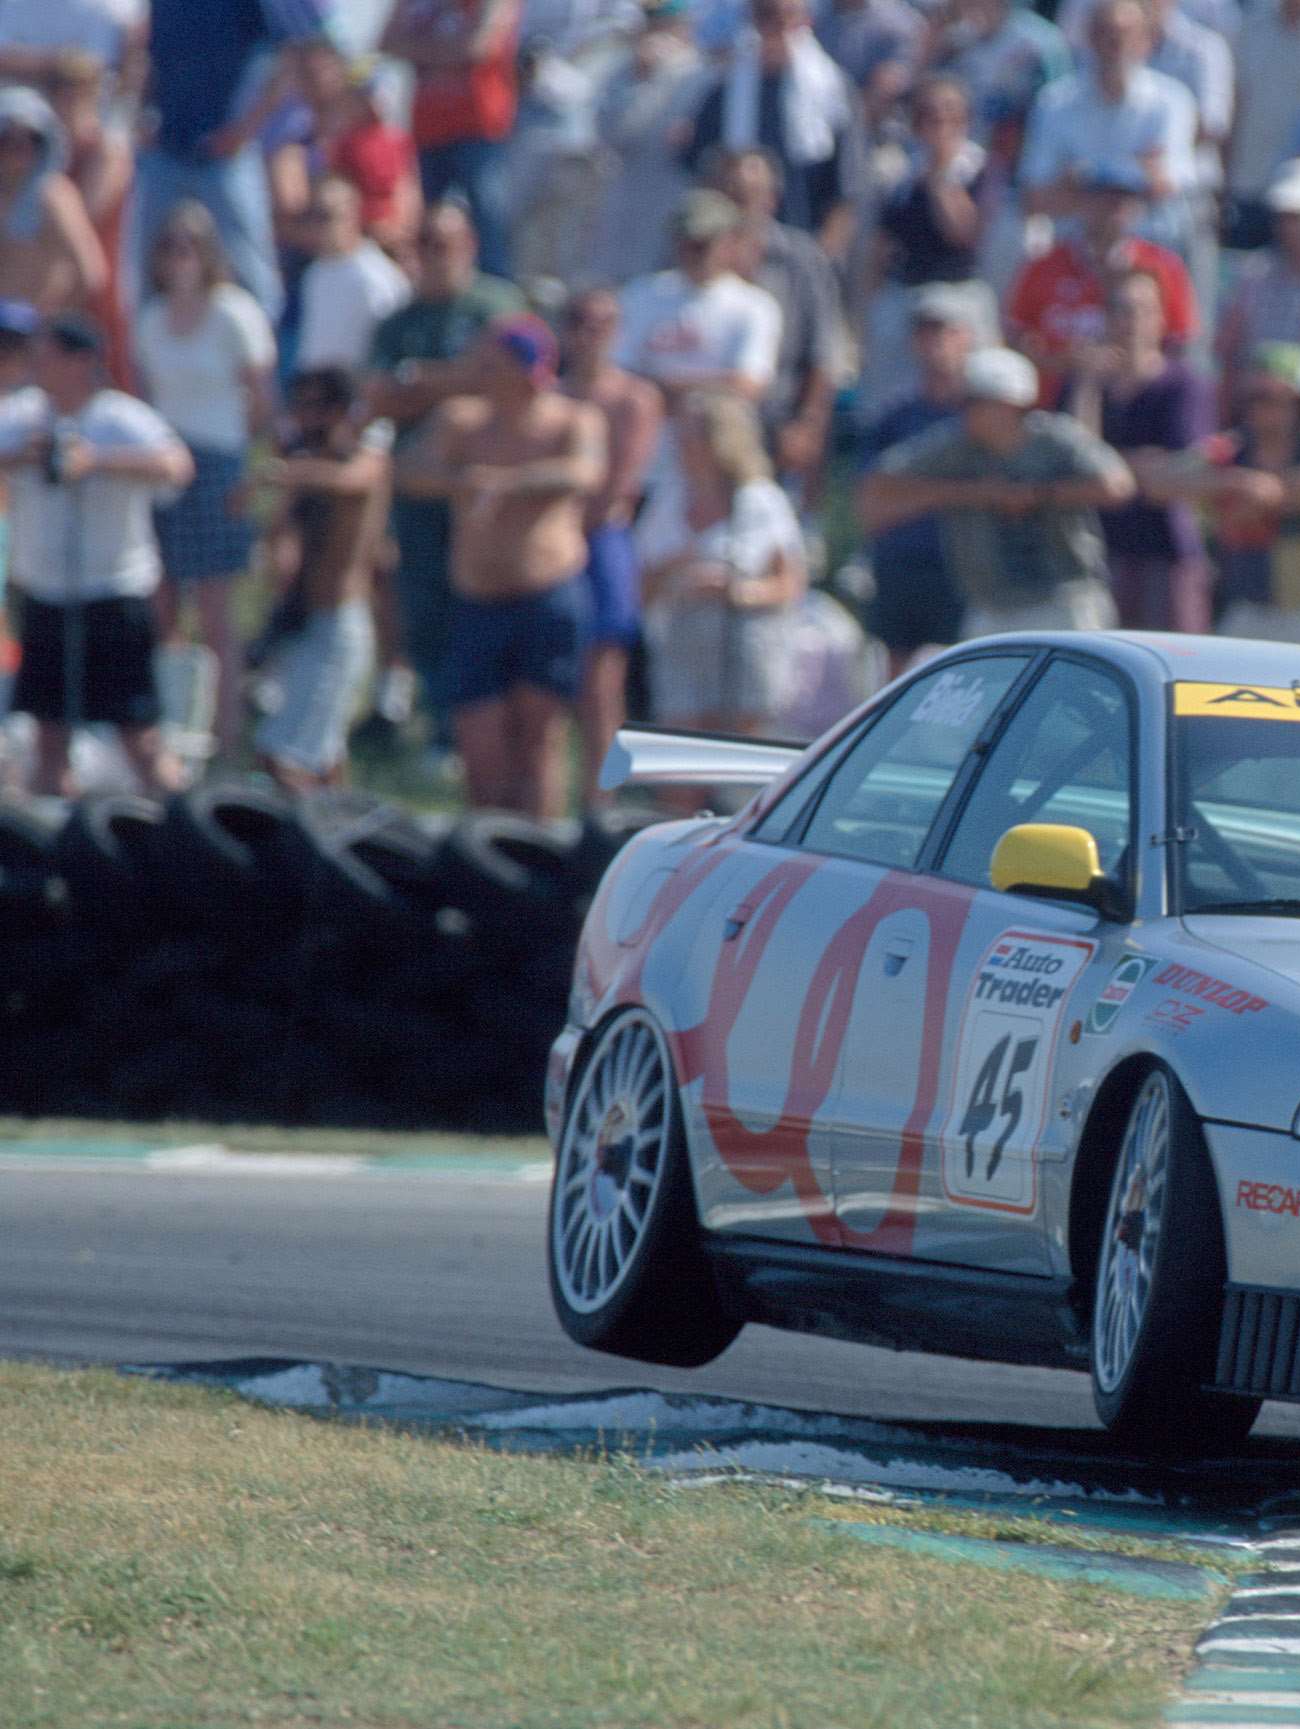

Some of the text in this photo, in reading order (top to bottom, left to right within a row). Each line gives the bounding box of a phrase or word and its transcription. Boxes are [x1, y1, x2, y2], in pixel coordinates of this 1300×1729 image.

[1002, 947, 1064, 975] Auto
[975, 971, 1065, 1009] Trader
[1152, 962, 1270, 1015] DUNLOP
[957, 1030, 1039, 1182] 45
